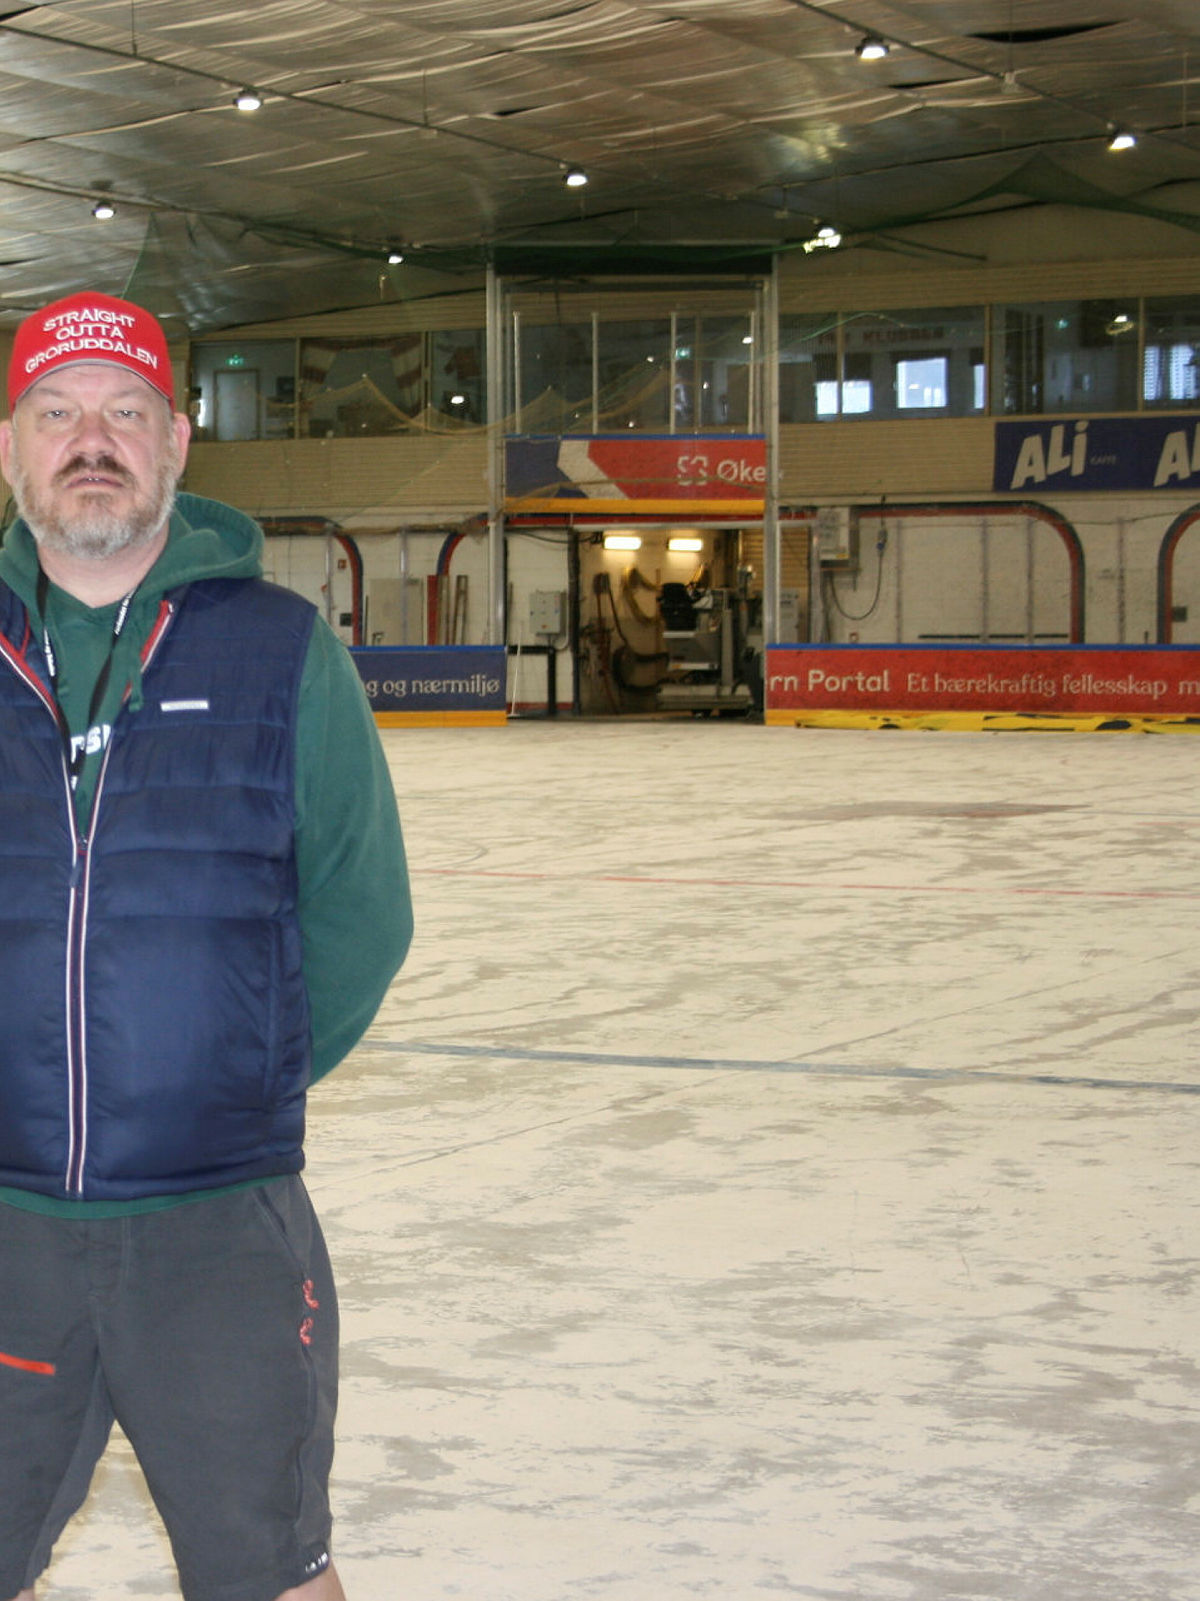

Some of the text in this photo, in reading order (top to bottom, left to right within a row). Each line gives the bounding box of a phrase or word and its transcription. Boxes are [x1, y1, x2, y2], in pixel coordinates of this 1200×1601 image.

[43, 308, 135, 331] STRAIGHT
[56, 324, 125, 340] OUTTA
[25, 338, 158, 373] GRORUDDALEN
[382, 679, 407, 697] og
[412, 674, 500, 697] nærmiljø
[766, 675, 798, 692] rn
[808, 669, 889, 692] Portal
[907, 673, 929, 693] Et
[934, 673, 1056, 697] bærekraftig
[1062, 674, 1167, 700] fellesskap
